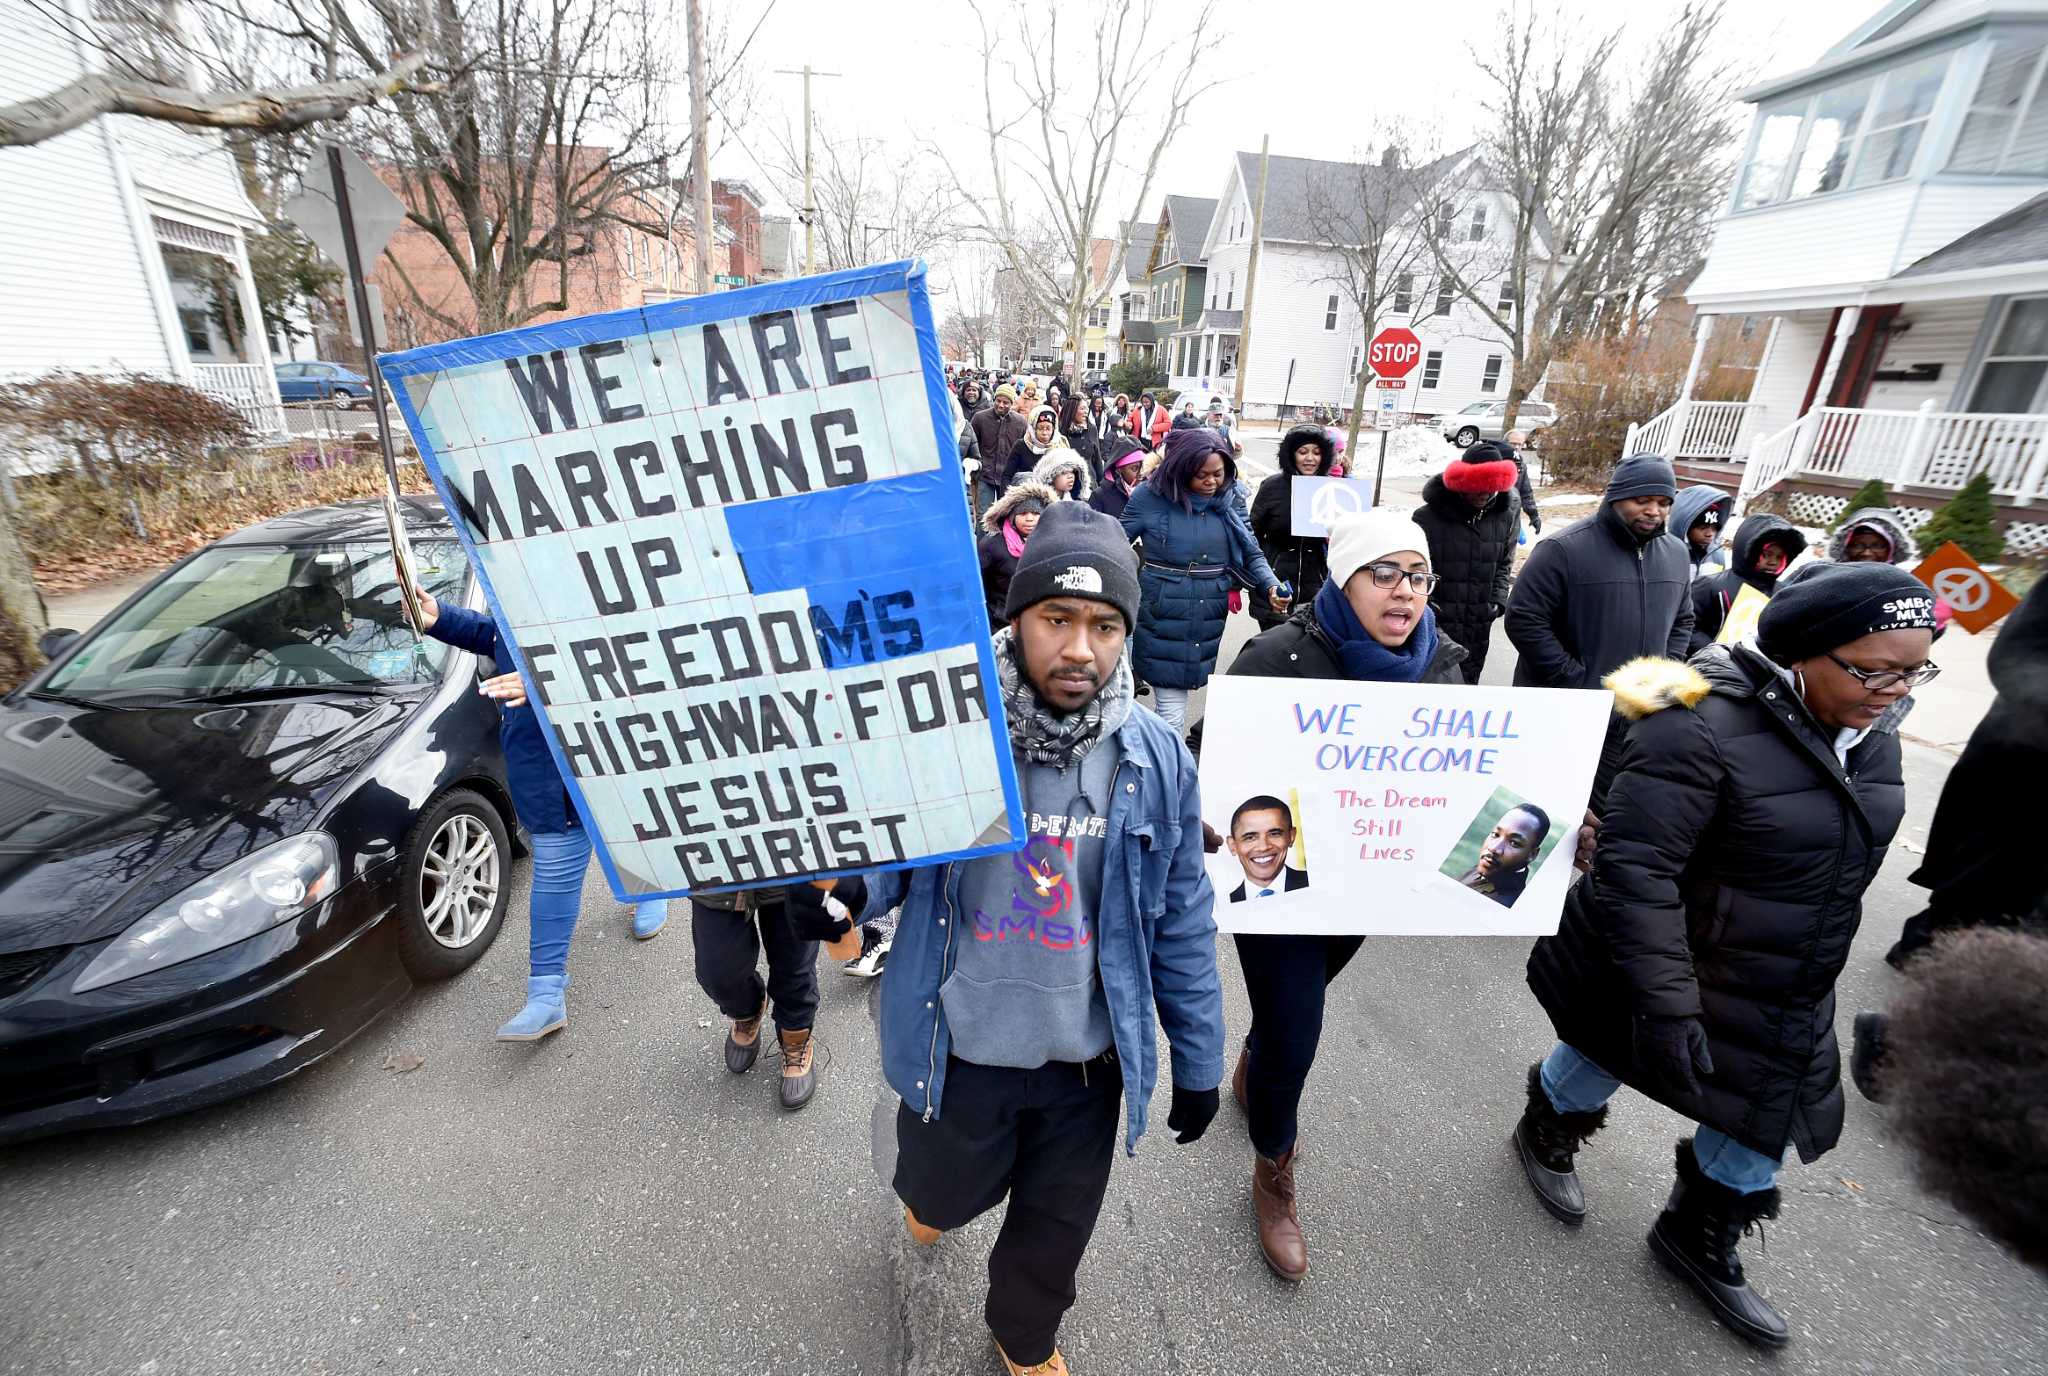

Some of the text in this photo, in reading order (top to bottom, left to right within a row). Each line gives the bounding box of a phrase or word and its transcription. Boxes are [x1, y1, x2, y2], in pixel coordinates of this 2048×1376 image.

[505, 300, 872, 434] WE ARE
[1372, 343, 1418, 362] STOP
[577, 537, 682, 615] UP
[1882, 597, 1933, 613] SMBC
[1896, 608, 1930, 621] MLK
[521, 589, 924, 705] FREEDOM'S
[845, 662, 989, 740] FOR
[1294, 702, 1520, 739] WE SHALL
[1315, 743, 1500, 775] OVERCOME
[633, 762, 847, 840] JESUS
[1334, 789, 1447, 809] The Dream
[1351, 819, 1402, 836] Still
[674, 815, 906, 889] CHRIST
[1359, 844, 1415, 861] Lives
